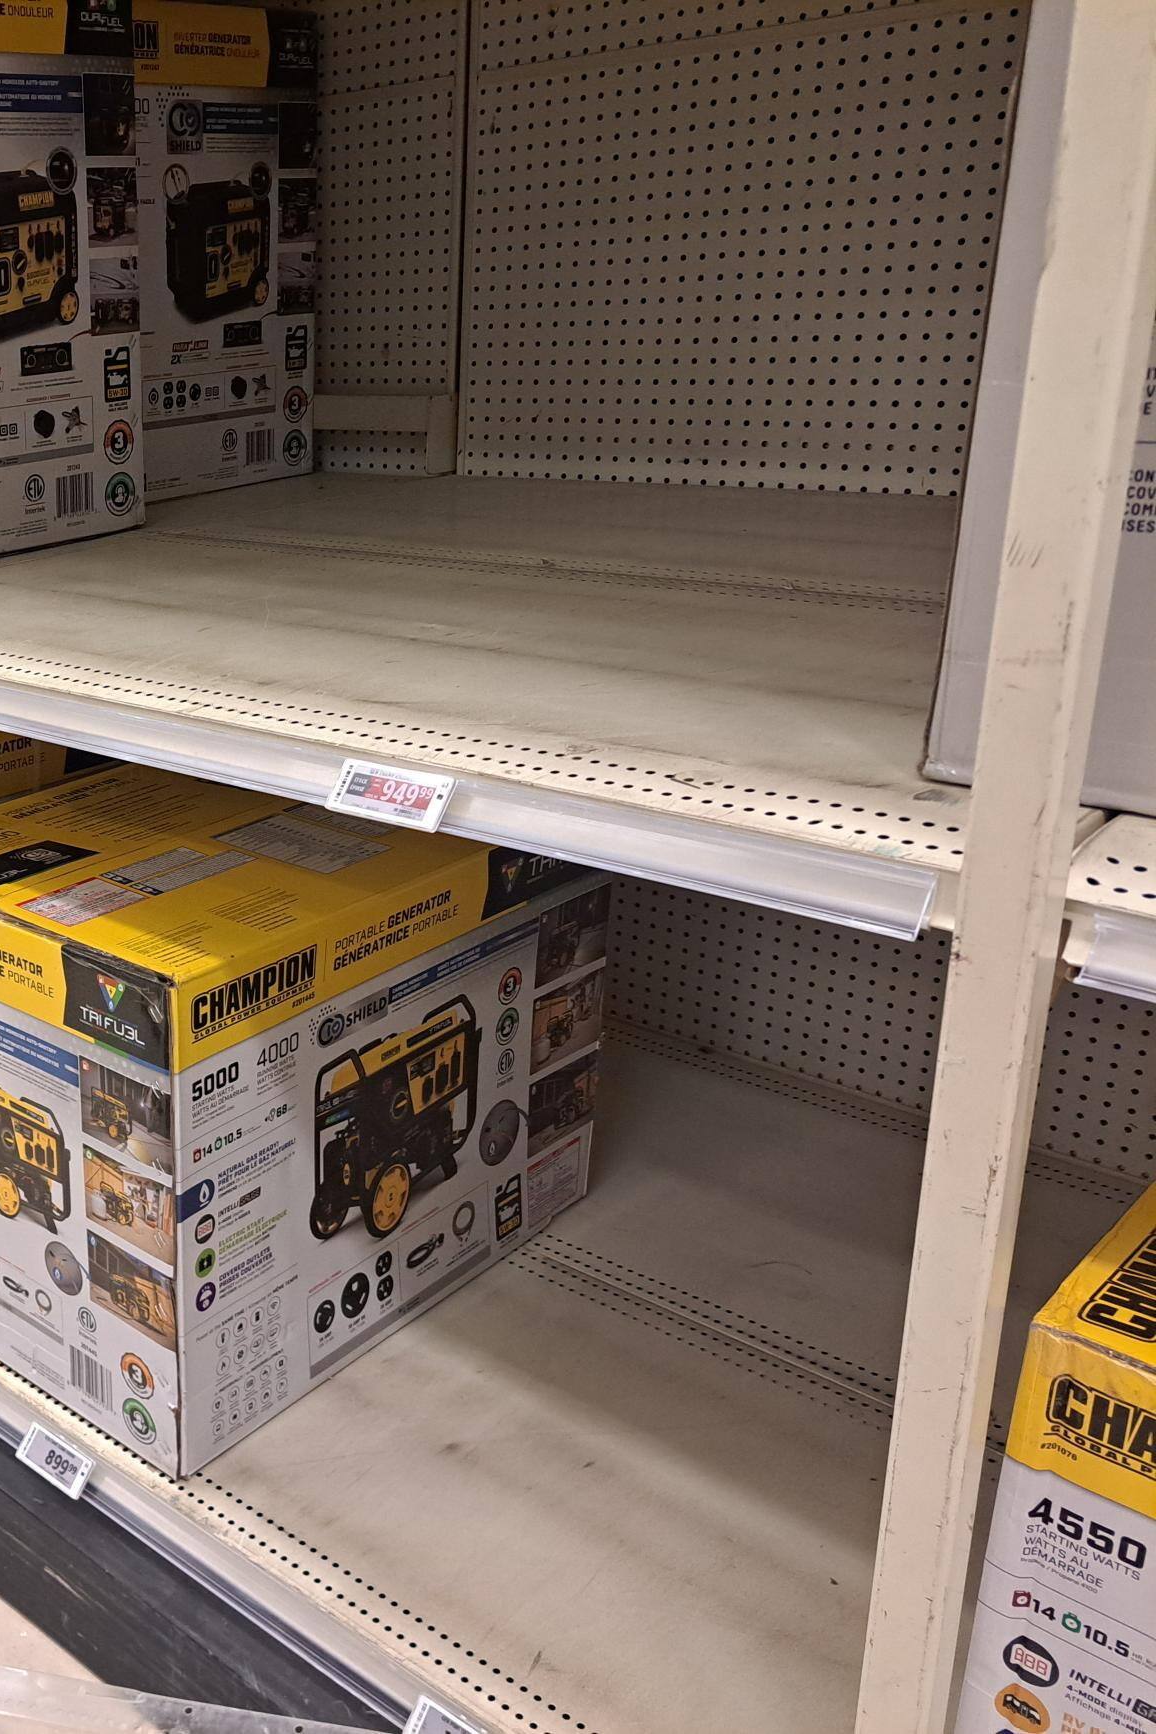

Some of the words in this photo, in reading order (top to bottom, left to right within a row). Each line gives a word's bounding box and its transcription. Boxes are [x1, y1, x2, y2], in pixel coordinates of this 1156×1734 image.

[8, 5, 54, 18] ONDULEUR
[170, 140, 202, 152] SHIELD
[107, 388, 128, 399] 5W-30
[332, 925, 411, 972] GÉNÉRATRICE
[411, 903, 459, 935] PORTABLE
[334, 919, 386, 954] PORTABLE
[387, 889, 452, 928] GENERATOR
[7, 969, 55, 999] PORTABLE
[192, 948, 316, 1033] CHAMPION
[194, 1018, 229, 1040] GLOBAL
[231, 1007, 262, 1025] POWER
[265, 981, 315, 1010] EQUIPMENT
[291, 992, 316, 1010] #201445
[345, 996, 388, 1028] SHIELD
[256, 1031, 300, 1067] 4000
[191, 1061, 240, 1102] 5000
[192, 1093, 215, 1111] STARTING
[216, 1085, 235, 1101] WATTS
[276, 1103, 288, 1118] 68
[202, 1144, 213, 1158] 14
[223, 1128, 243, 1146] 10.5
[218, 1162, 245, 1179] NATURAL
[246, 1153, 258, 1163] GAS
[218, 1173, 234, 1187] PRÊT
[234, 1165, 250, 1178] POUR
[250, 1161, 258, 1170] LE
[258, 1154, 271, 1165] GAZ
[218, 1226, 246, 1247] ELECTRIC
[246, 1215, 265, 1233] START
[218, 1262, 245, 1282] COVERED
[245, 1246, 271, 1266] OUTLETS
[1050, 1424, 1132, 1467] GLOBAL
[1027, 1497, 1148, 1570] 4550
[1022, 1545, 1104, 1589] DÉMARRAGE
[1024, 1536, 1066, 1560] WATTS
[1070, 1554, 1090, 1570] AU
[1026, 1523, 1088, 1557] STARTING
[1092, 1551, 1142, 1581] WATTS
[1032, 1599, 1056, 1621] 14
[1083, 1624, 1131, 1658] 10.5
[1066, 1684, 1109, 1709] 4-MODE
